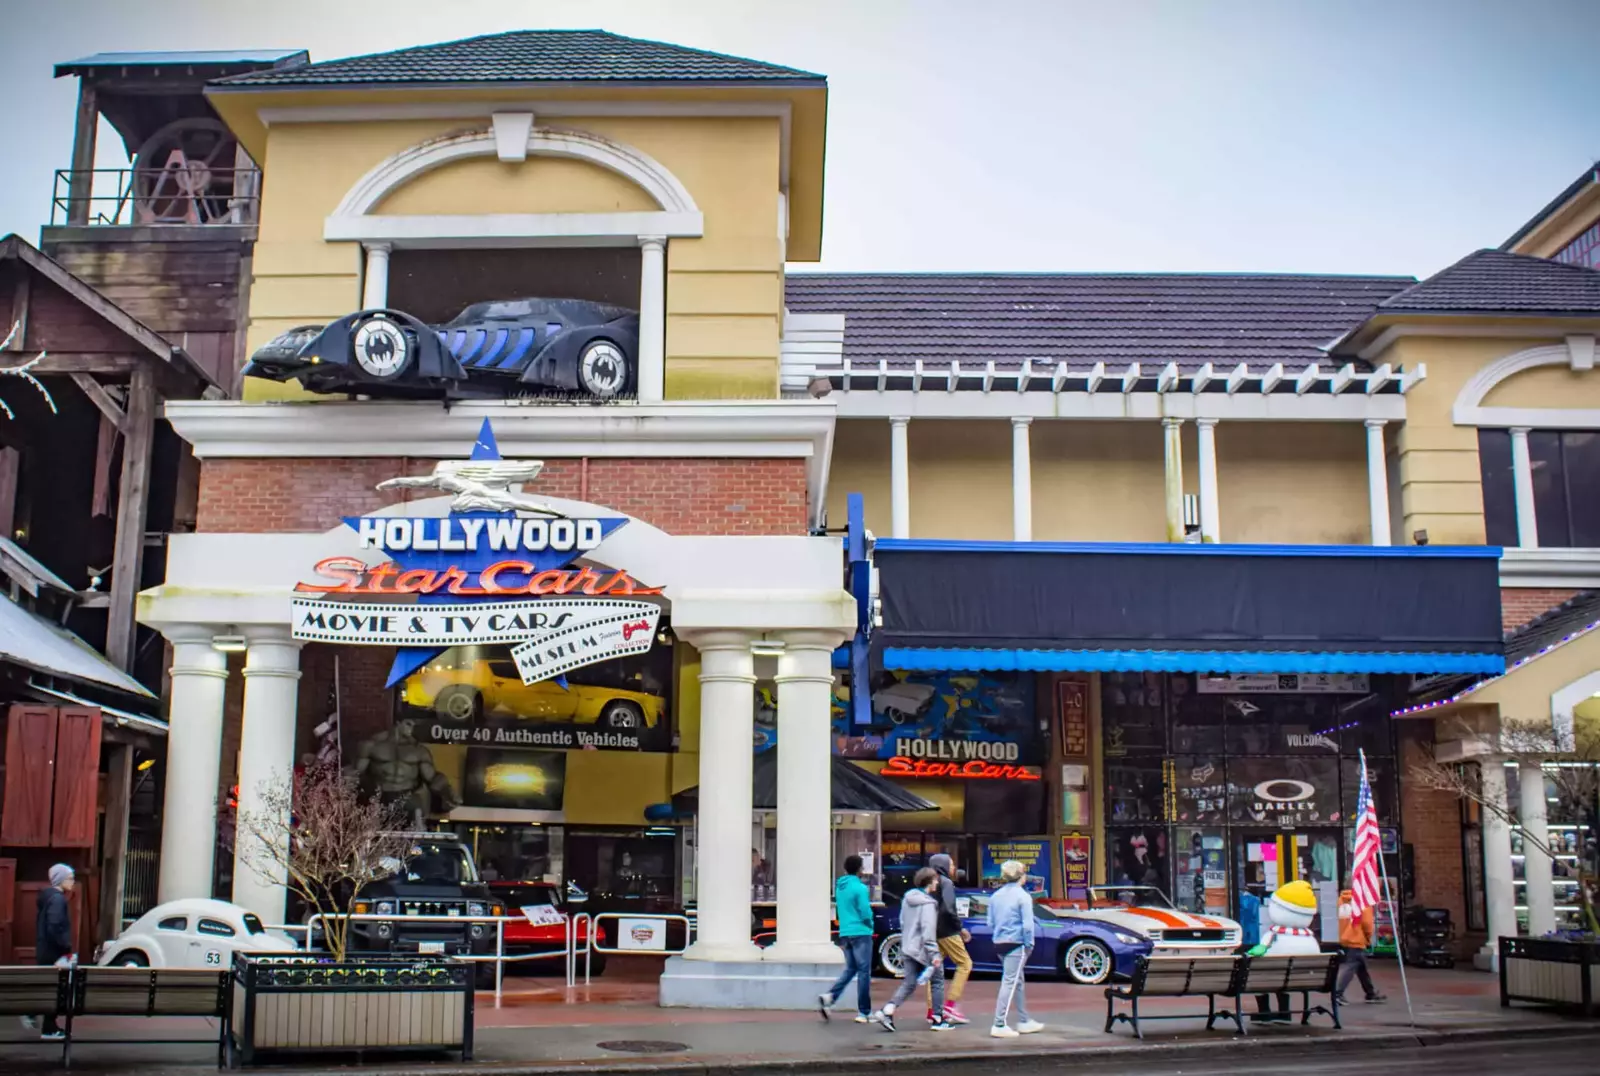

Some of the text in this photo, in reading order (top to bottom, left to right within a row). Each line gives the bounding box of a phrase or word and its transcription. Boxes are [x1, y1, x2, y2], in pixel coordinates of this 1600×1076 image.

[358, 518, 603, 552] HOLLYWOOD
[294, 556, 667, 596] Star Cars
[302, 612, 573, 634] MOVIE & TV CARS
[520, 634, 598, 670] MUSEUM
[431, 725, 639, 748] Over 40 Authentic Vehicles
[1287, 734, 1323, 747] VOLCOM
[896, 738, 1019, 760] HOLLYWOOD
[881, 756, 1041, 780] Star Cars
[1254, 802, 1316, 811] OAKLEY
[1205, 871, 1224, 880] RIDE
[207, 952, 220, 964] 53
